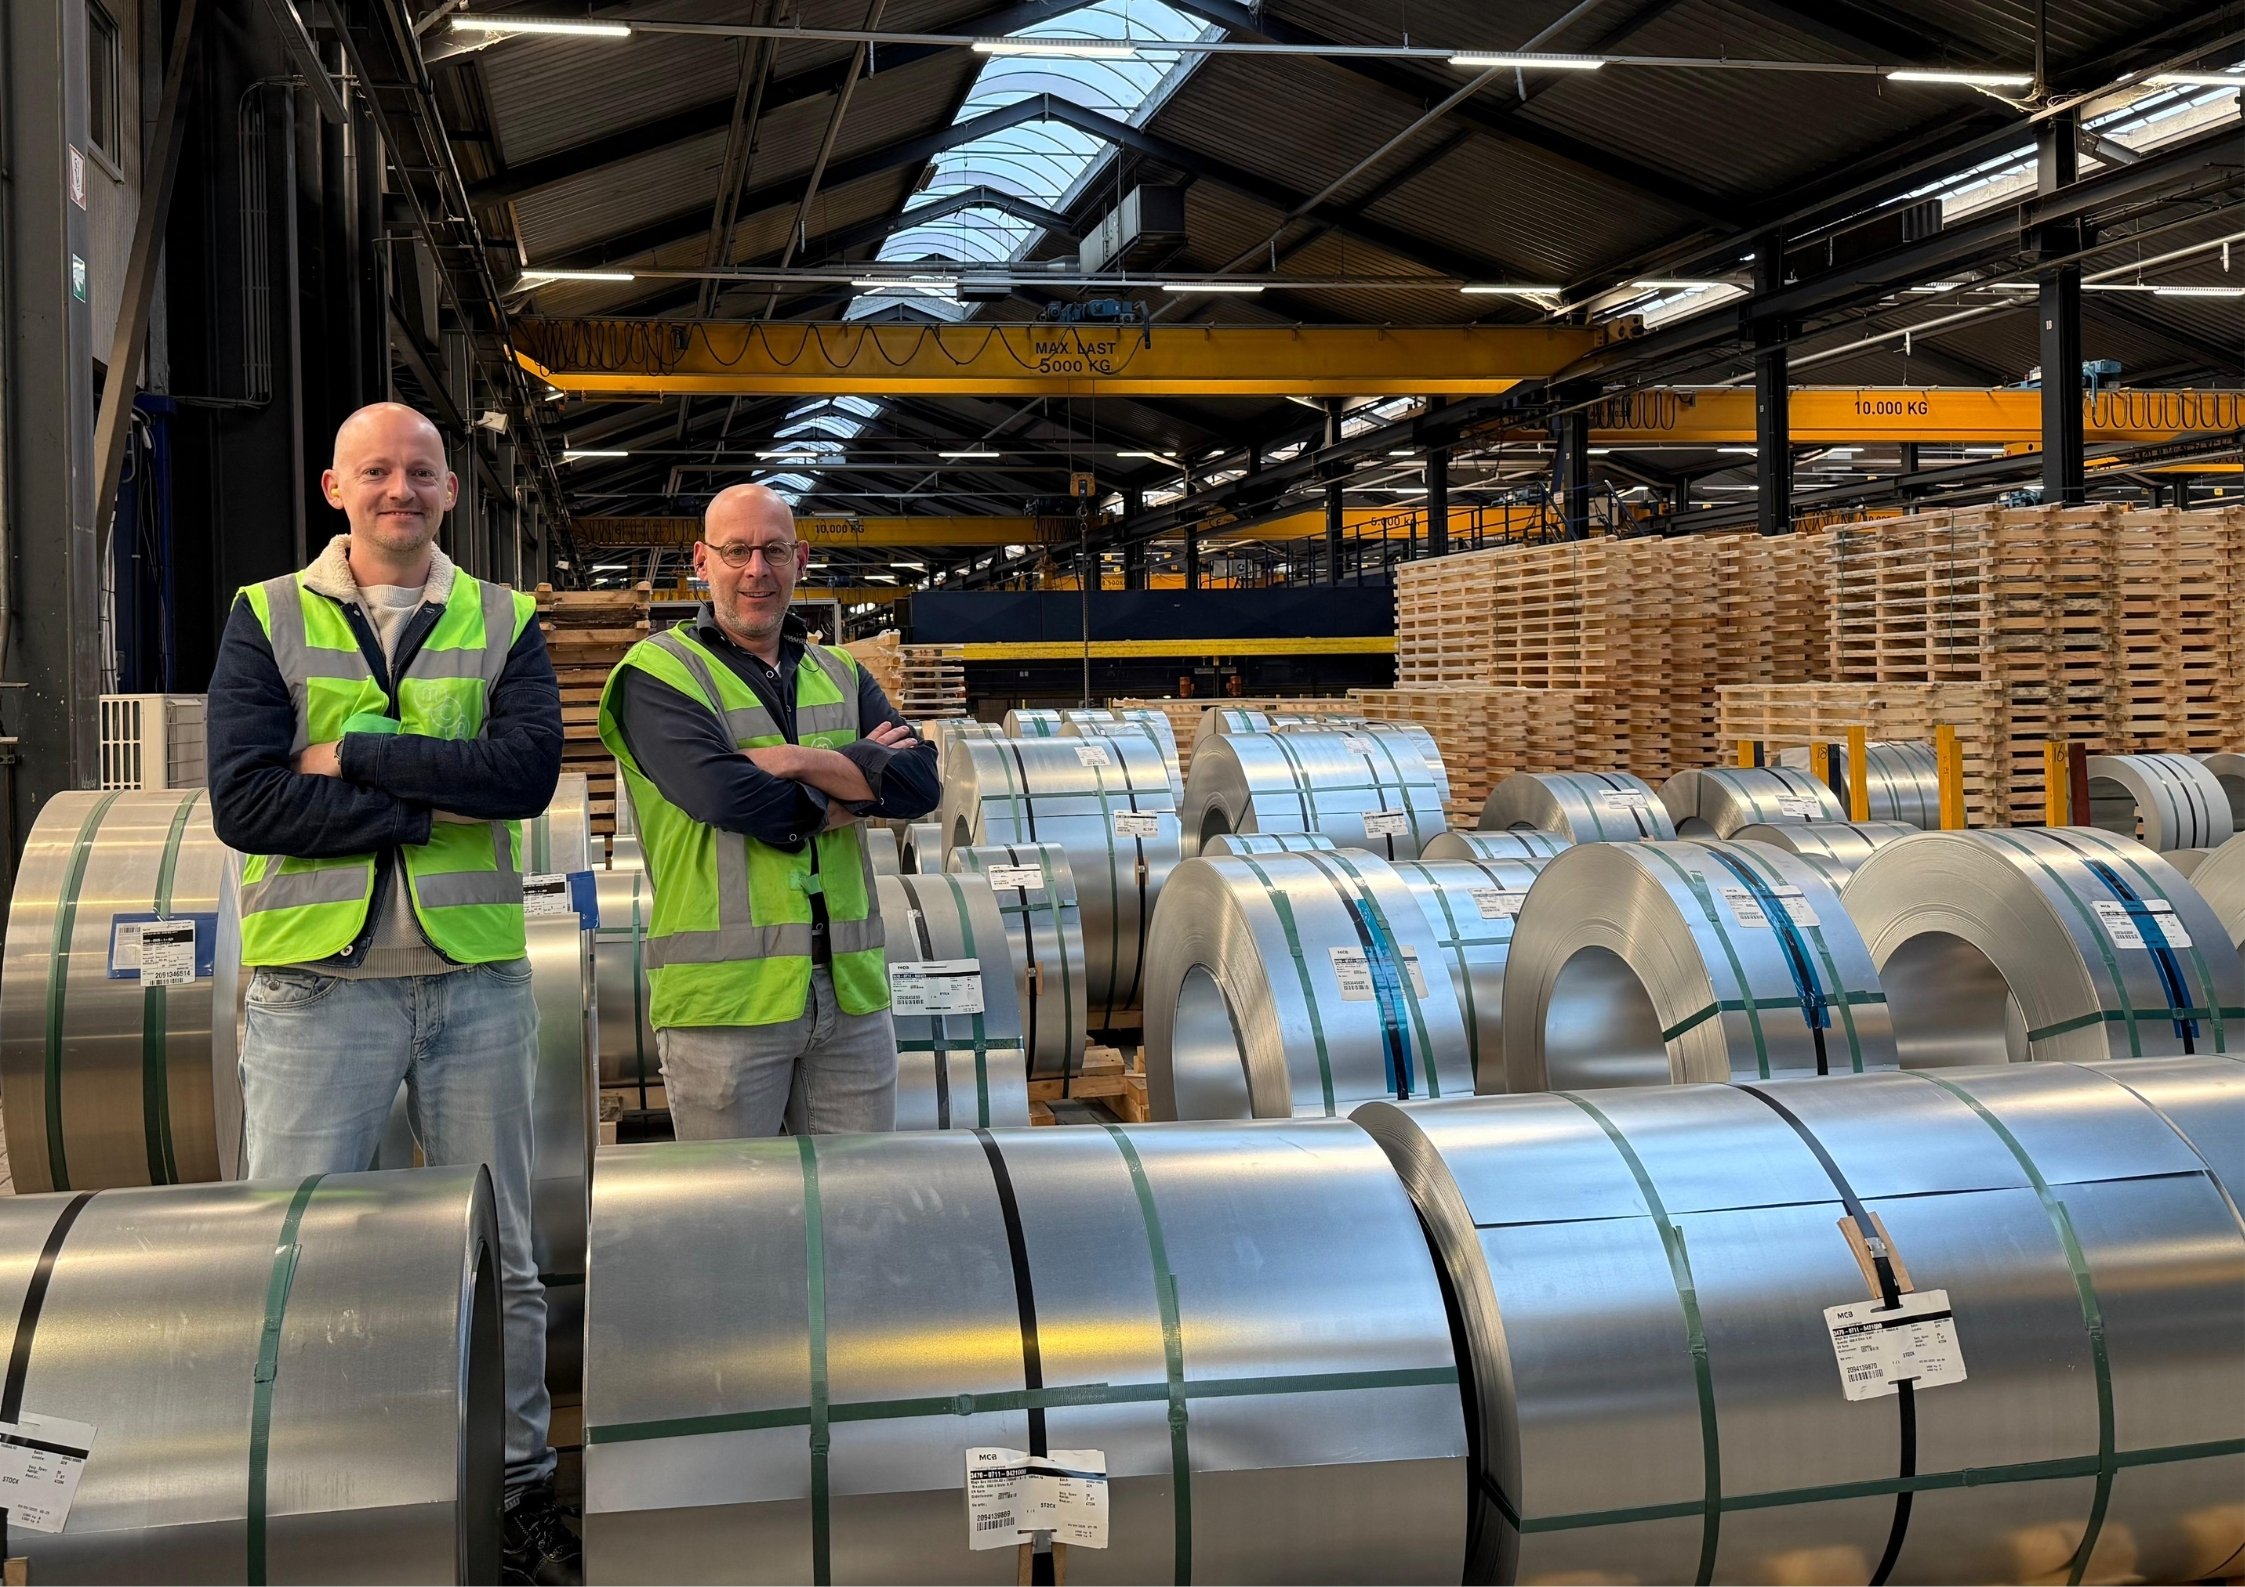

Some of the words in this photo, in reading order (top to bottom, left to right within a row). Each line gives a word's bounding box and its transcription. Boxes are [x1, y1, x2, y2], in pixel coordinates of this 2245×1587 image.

[1077, 342, 1117, 354] LAST
[1039, 358, 1083, 373] 5000
[1854, 401, 1903, 415] 10.000
[1908, 401, 1928, 415] KG
[816, 524, 848, 534] 10.000
[1837, 1310, 1854, 1319] MCB
[979, 1453, 998, 1461] MCB
